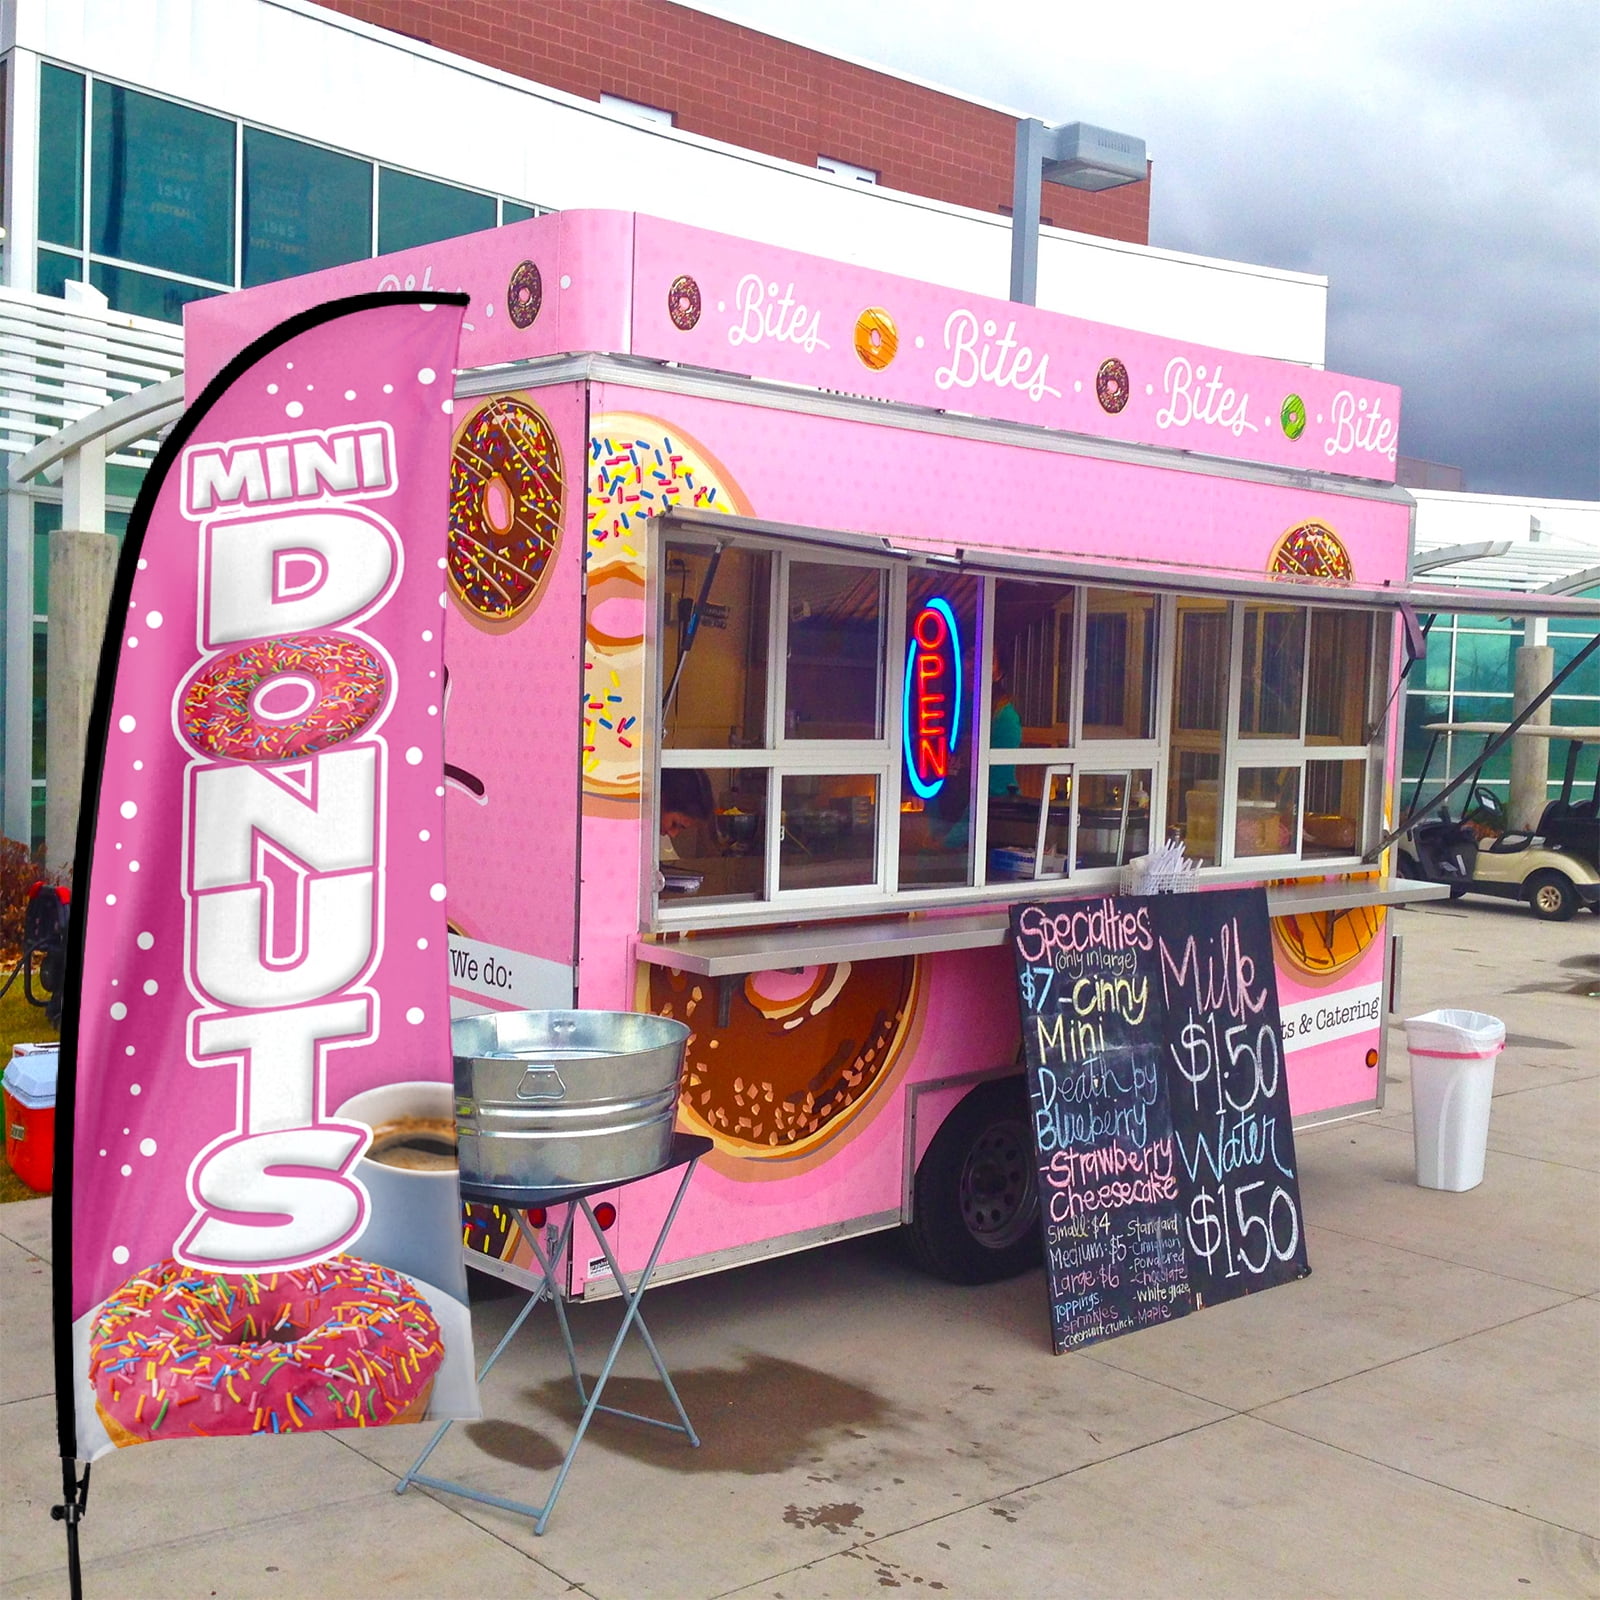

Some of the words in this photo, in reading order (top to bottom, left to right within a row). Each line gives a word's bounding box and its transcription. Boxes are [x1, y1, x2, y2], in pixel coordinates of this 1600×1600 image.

[728, 274, 830, 353] Bites
[935, 308, 1062, 402] Bites
[1156, 356, 1258, 437] Bites
[181, 421, 398, 521] MINI
[914, 608, 947, 778] OPEN
[172, 501, 405, 1274] DONUTS
[450, 949, 478, 981] We
[484, 957, 512, 989] do:
[1020, 963, 1054, 1013] $7
[1159, 917, 1267, 1022] Milk
[1037, 1013, 1104, 1065] Mini
[1299, 1014, 1312, 1034] &
[1316, 997, 1380, 1031] Catering
[1131, 1052, 1158, 1105] by
[1170, 1007, 1278, 1115] $1.50
[1036, 1102, 1147, 1150] Blueberry
[1176, 1114, 1294, 1182] Water
[1091, 1212, 1111, 1239] $4
[1186, 1180, 1298, 1278] $1.50
